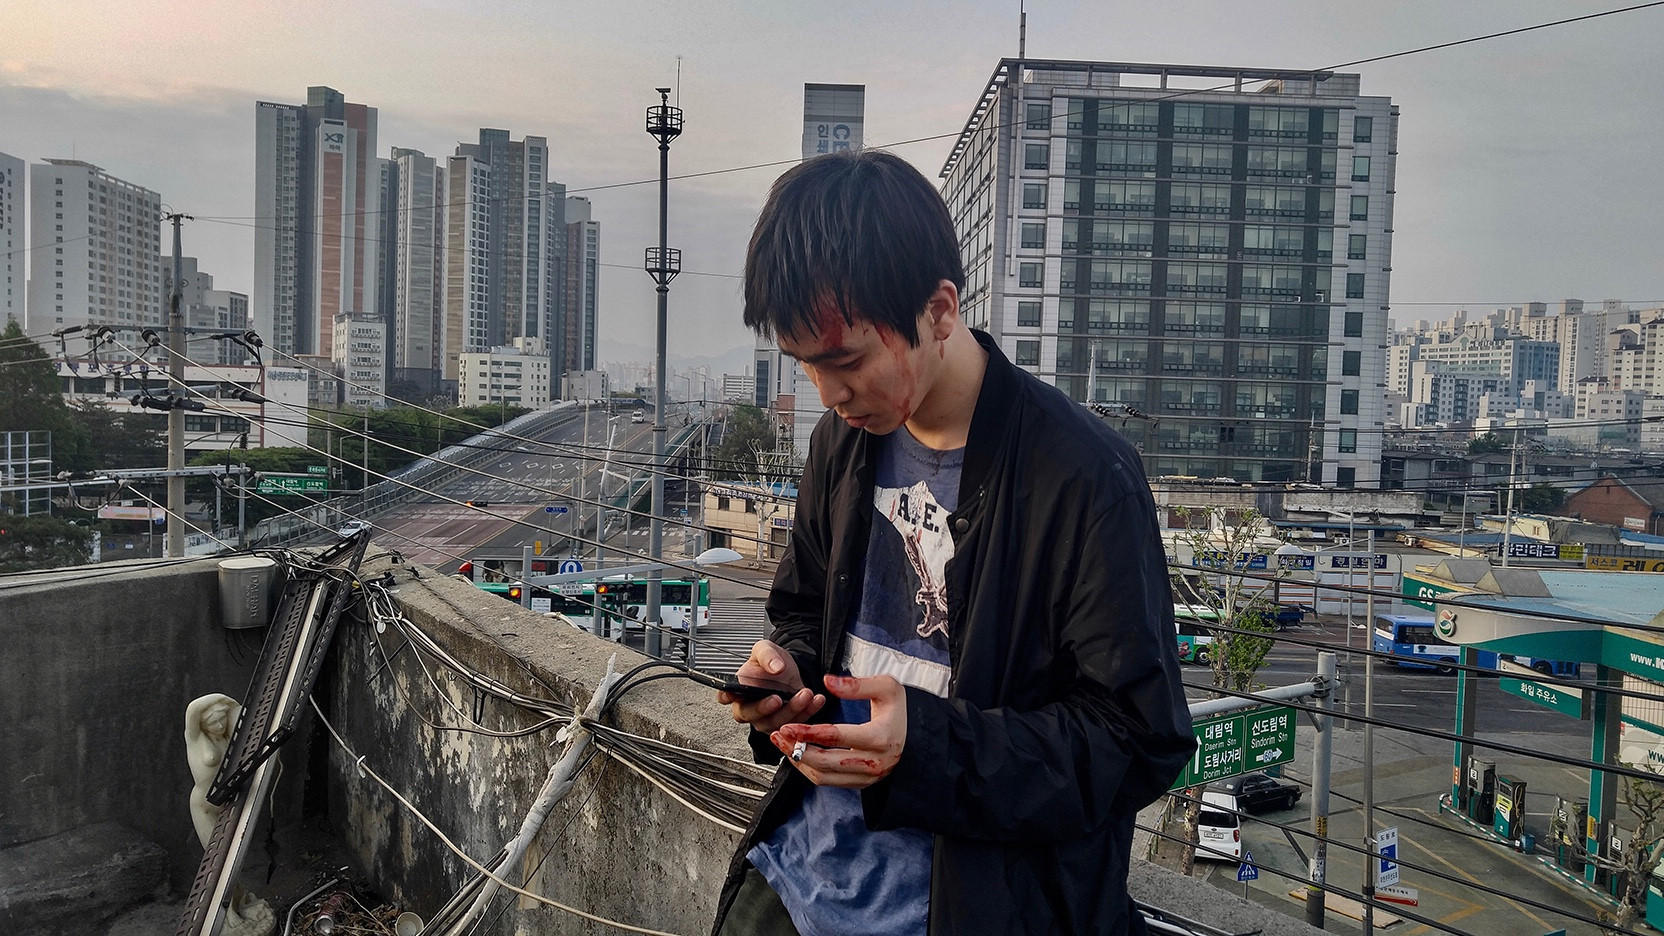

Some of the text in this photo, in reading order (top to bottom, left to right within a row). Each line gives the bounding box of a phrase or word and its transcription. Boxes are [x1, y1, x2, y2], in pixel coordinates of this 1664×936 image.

[1536, 688, 1557, 704] 주유소
[1205, 721, 1233, 739] 대림역
[1252, 714, 1288, 736] 신도림역
[1204, 738, 1236, 751] Daerim Stn
[1251, 732, 1288, 749] Sindorim Stn
[1204, 747, 1241, 768] 도림사거리
[1203, 769, 1220, 779] Dorim
